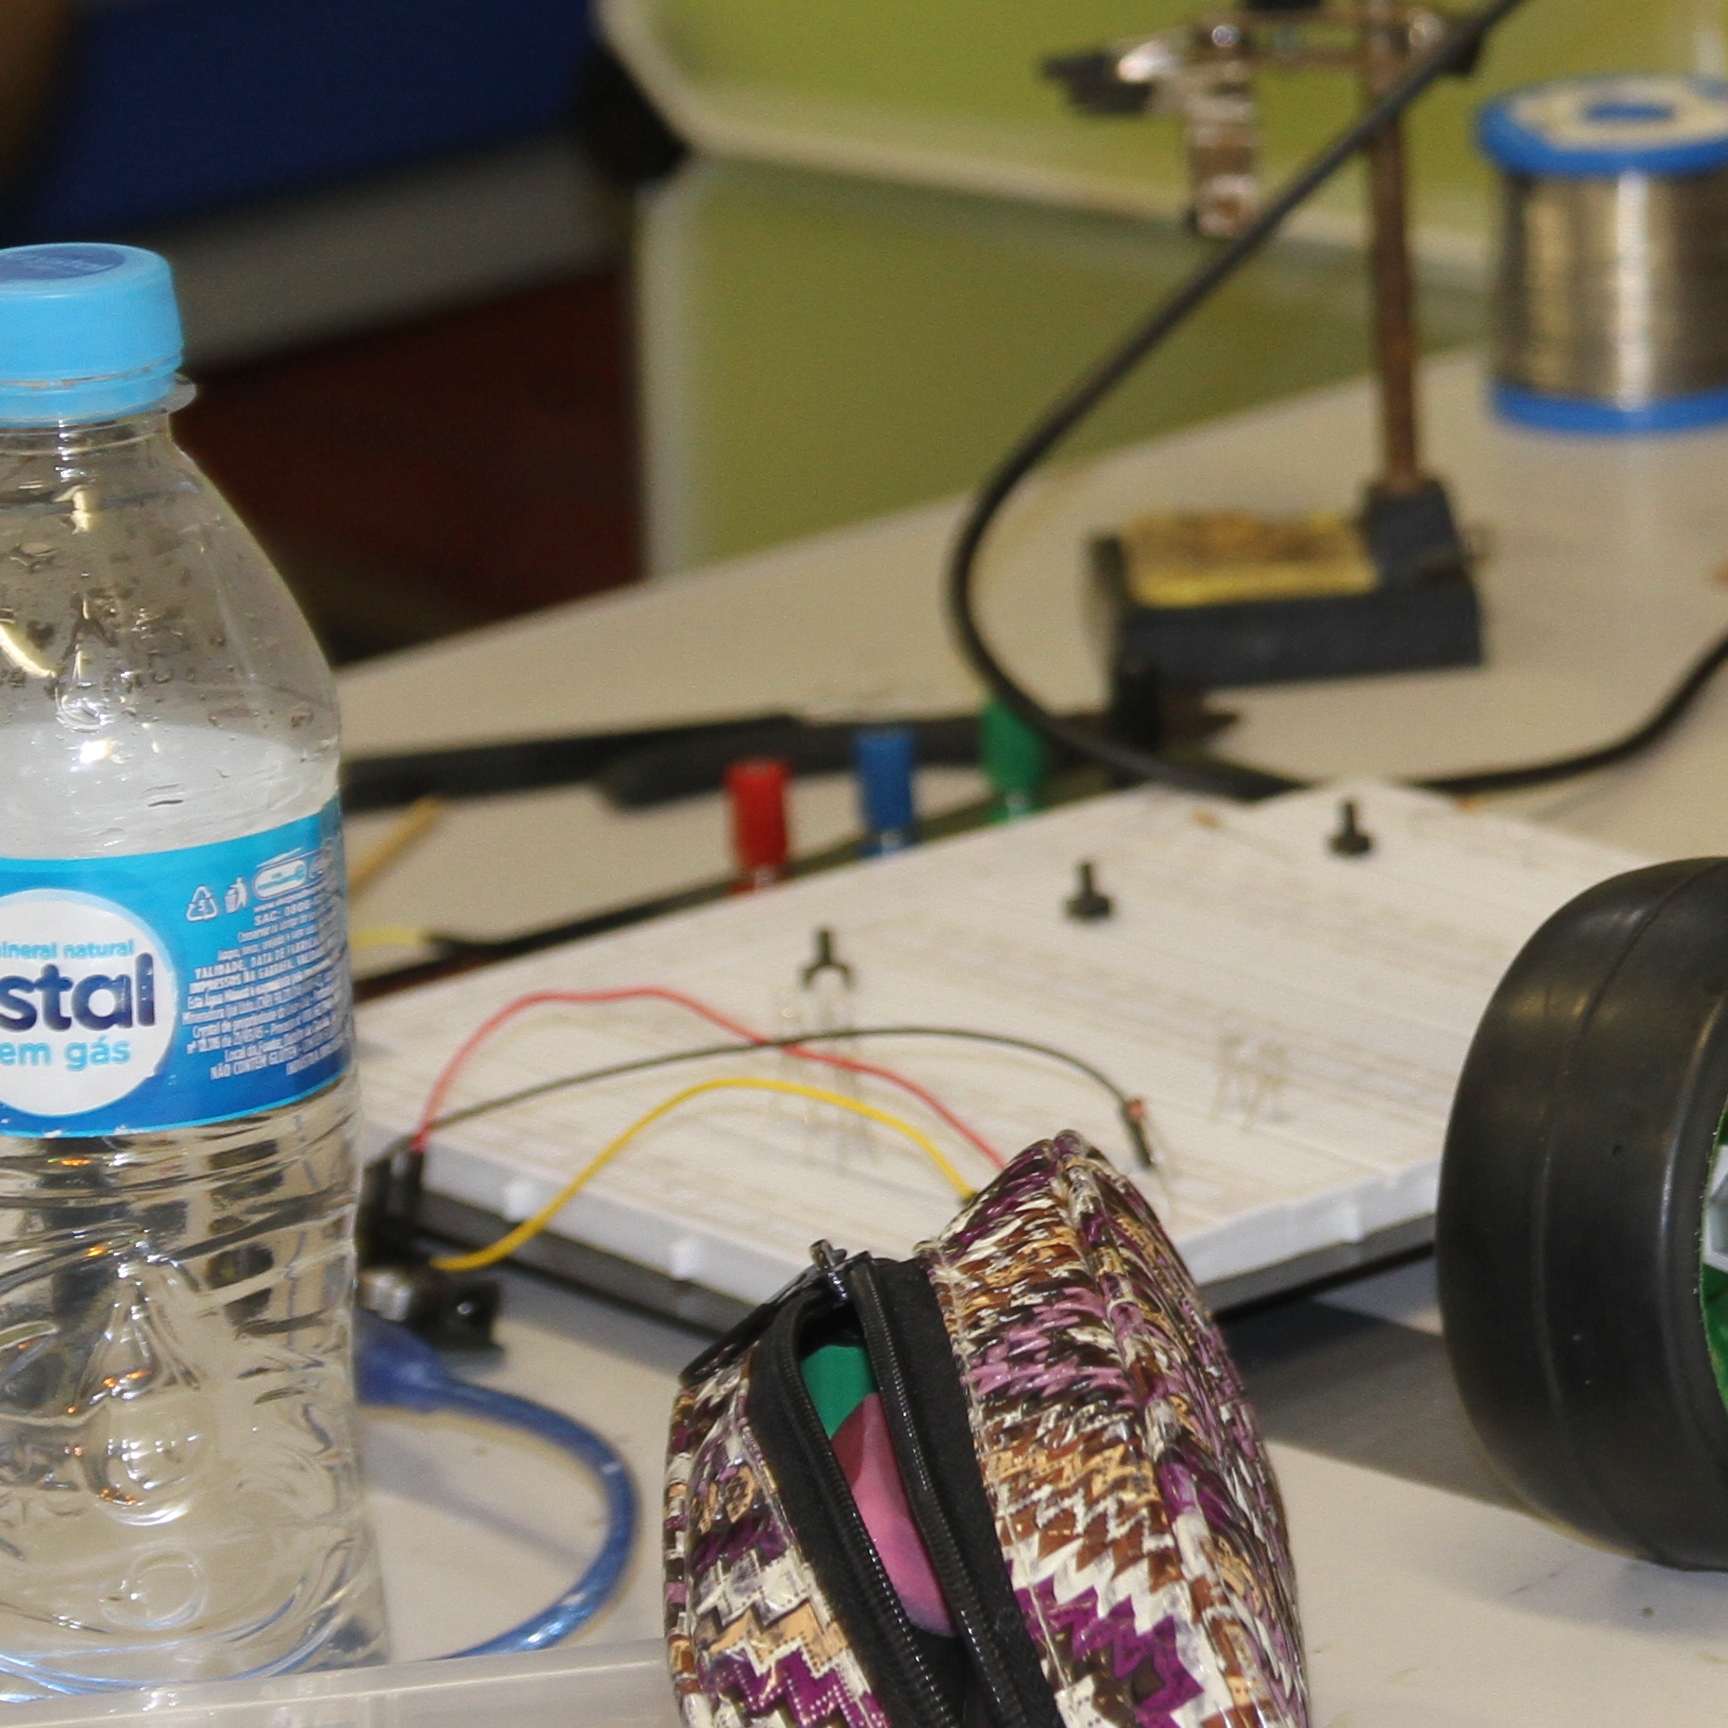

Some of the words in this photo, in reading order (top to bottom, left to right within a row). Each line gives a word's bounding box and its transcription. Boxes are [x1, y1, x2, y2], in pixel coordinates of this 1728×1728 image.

[0, 941, 58, 960] ineral
[63, 938, 134, 960] natural
[0, 952, 155, 1032] stal
[0, 1041, 52, 1068] em
[65, 1035, 132, 1072] gás
